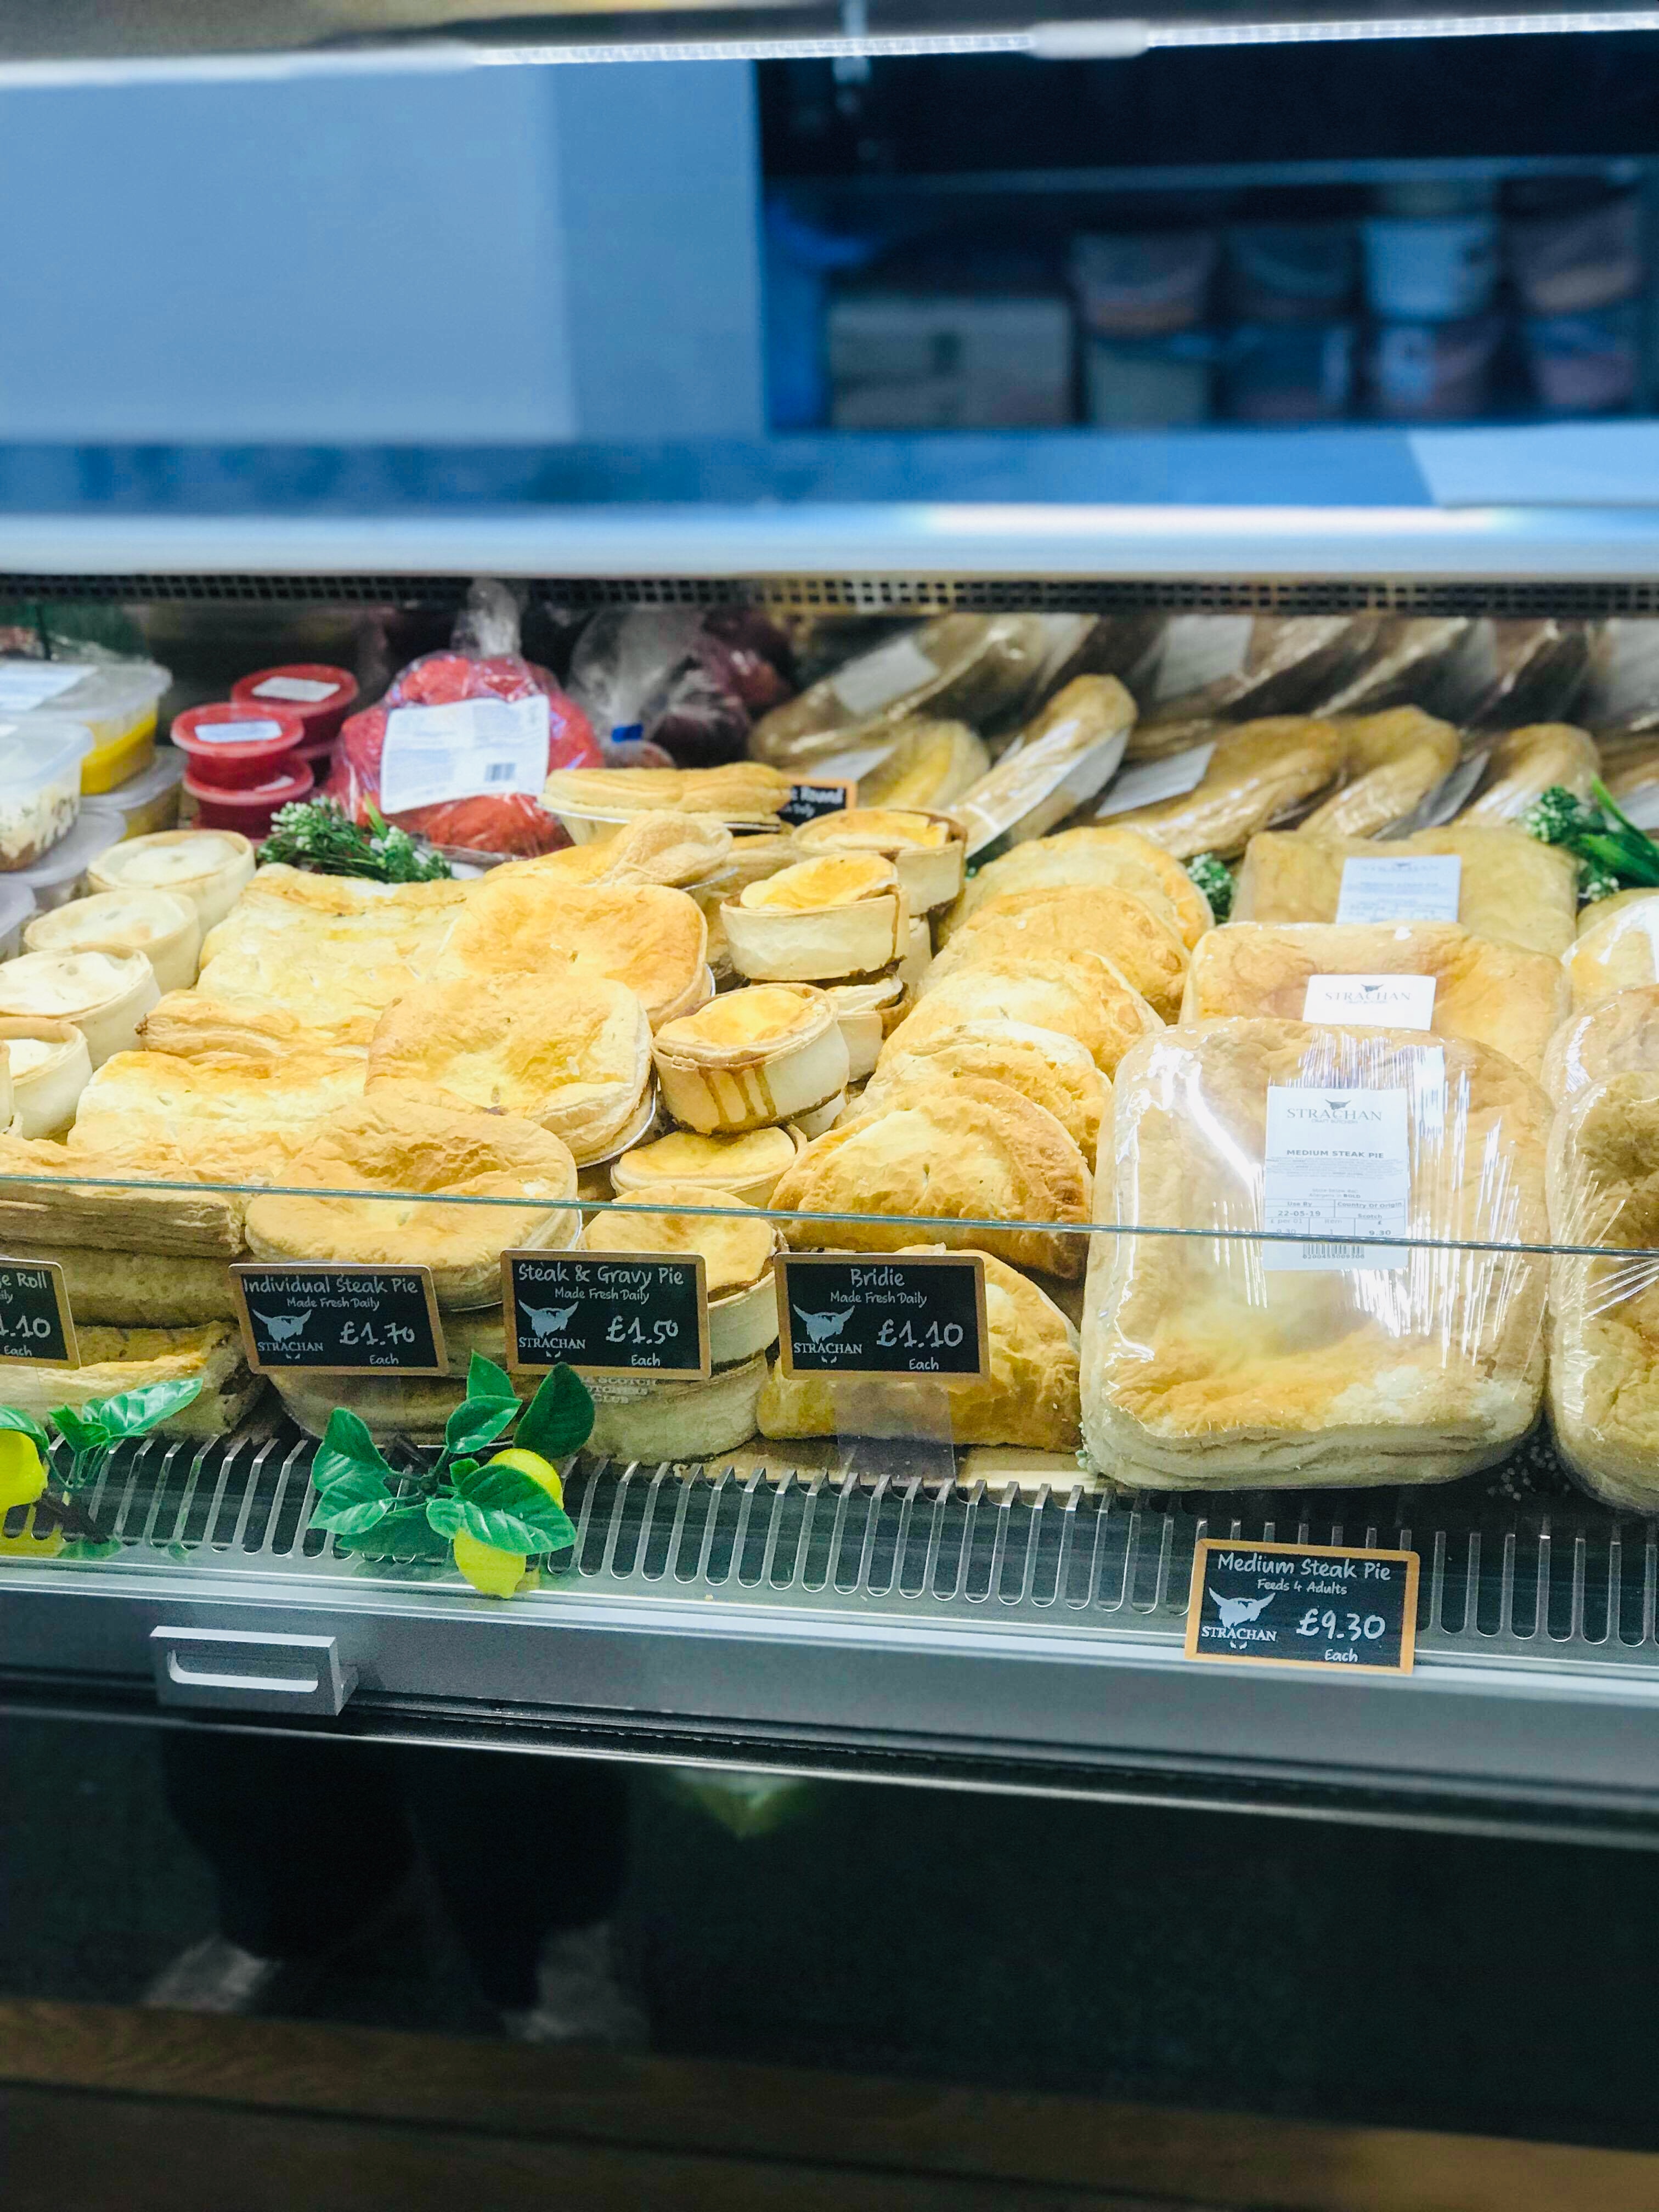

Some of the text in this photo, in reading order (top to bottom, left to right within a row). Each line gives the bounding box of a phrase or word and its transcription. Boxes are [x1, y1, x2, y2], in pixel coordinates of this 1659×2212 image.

[1325, 992, 1411, 1000] STRACHAN
[1287, 1108, 1381, 1121] STRACHAN
[16, 1271, 47, 1289] Roll
[518, 1262, 684, 1290] Steak & Gravy Pie
[850, 1266, 905, 1288] Bridie
[244, 1276, 418, 1294] Individual Steak Pie
[286, 1296, 380, 1311] Made Fresh Daily
[555, 1286, 650, 1305] Made Fresh Daily
[830, 1291, 927, 1308] Made Fresh Daily
[339, 1321, 415, 1346] £1.70
[605, 1315, 679, 1345] £1.50
[876, 1318, 964, 1348] £1.10
[4, 1344, 33, 1357] Each
[257, 1342, 324, 1352] STRACHAN
[518, 1336, 586, 1350] STRACHAN
[793, 1342, 862, 1355] STRACHAN
[369, 1352, 399, 1365] Each
[631, 1352, 661, 1367] Each
[909, 1357, 939, 1370] Each
[1218, 1553, 1391, 1581] Medium Steak Pie
[1257, 1578, 1348, 1595] Feeds 4 Adults
[1296, 1608, 1386, 1641] £9.30
[1201, 1626, 1277, 1642] STRACHAN
[1325, 1648, 1358, 1663] Each
